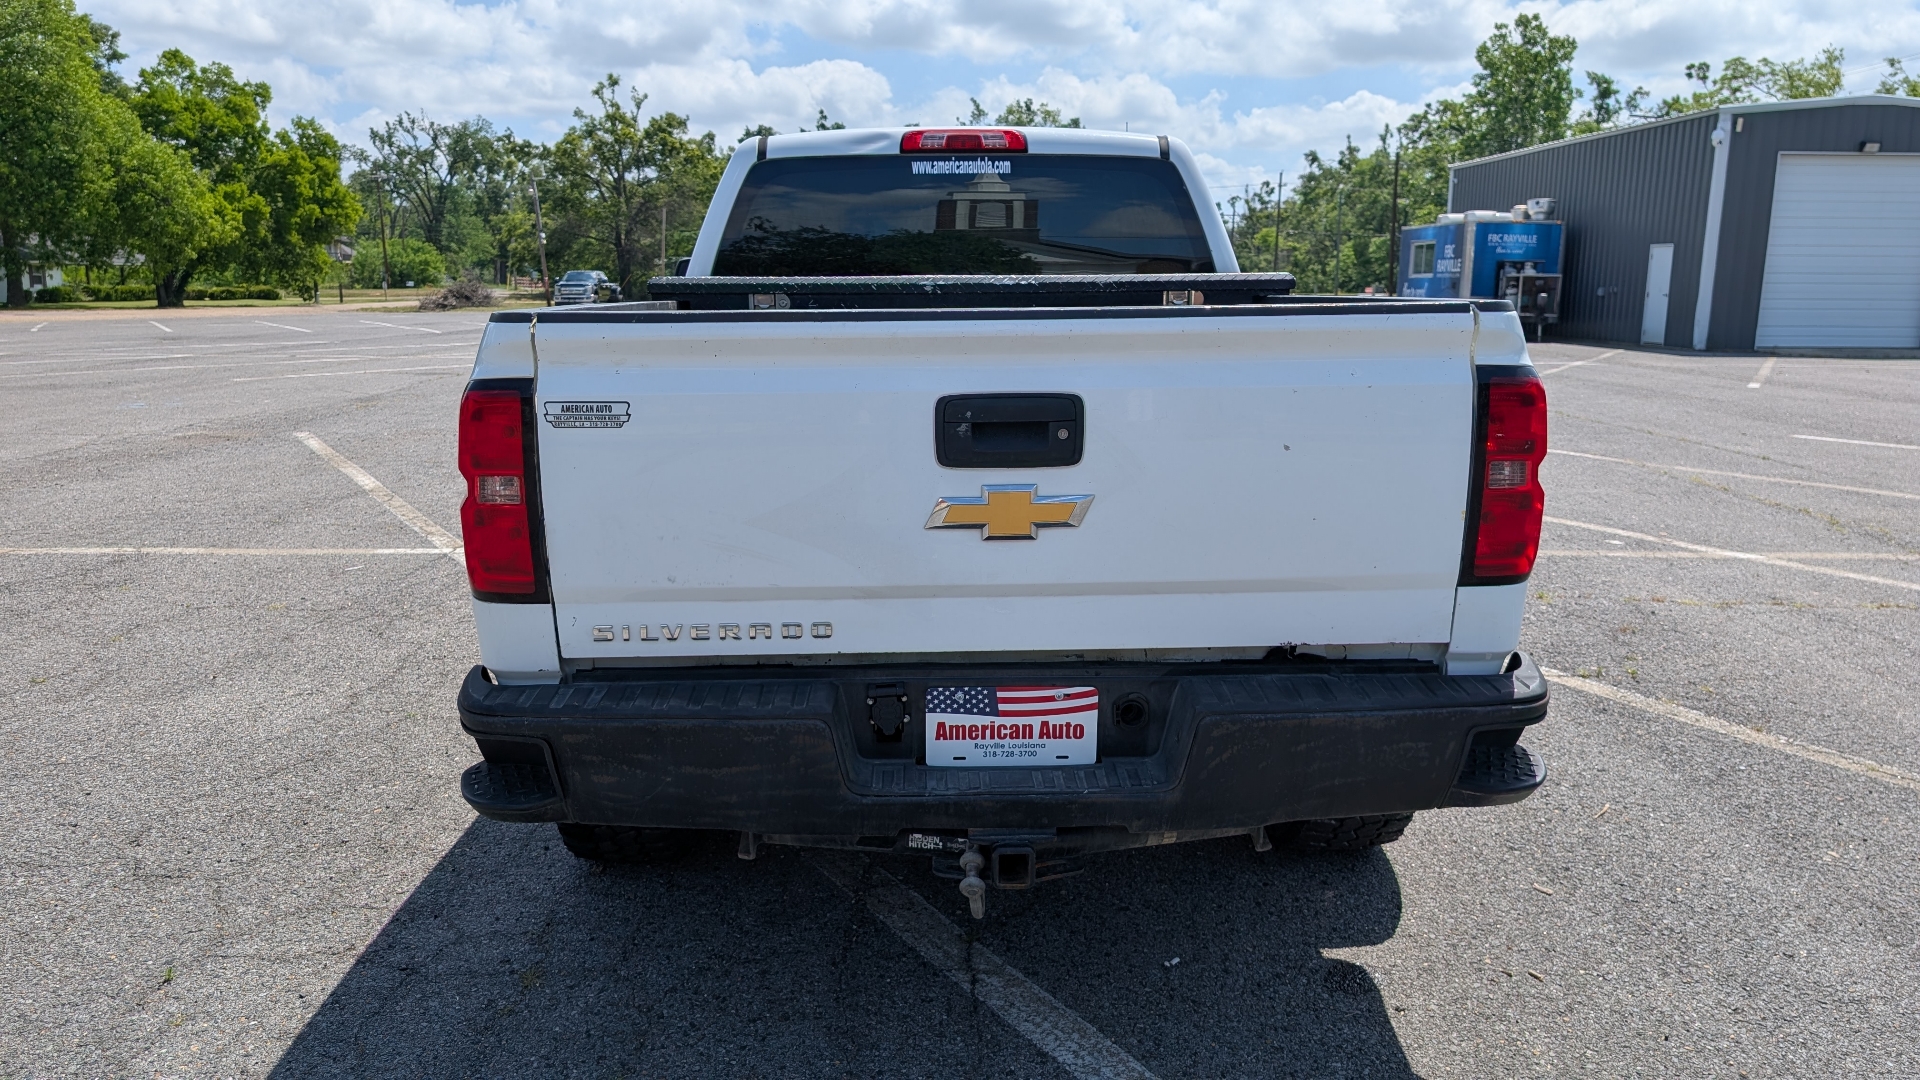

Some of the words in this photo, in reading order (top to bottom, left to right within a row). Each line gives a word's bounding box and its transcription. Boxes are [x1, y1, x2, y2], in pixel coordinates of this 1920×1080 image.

[911, 157, 1011, 174] www.americanautola.com
[1503, 234, 1538, 243] RAYVILLE
[561, 404, 594, 413] AMERICAN
[596, 404, 612, 413] AUTO
[593, 621, 833, 642] SILVERADO
[935, 720, 1034, 741] American
[1038, 720, 1085, 740] Auto
[974, 742, 1006, 750] Rayville
[983, 750, 1038, 758] 318-728-3700
[909, 841, 934, 849] HITCH
